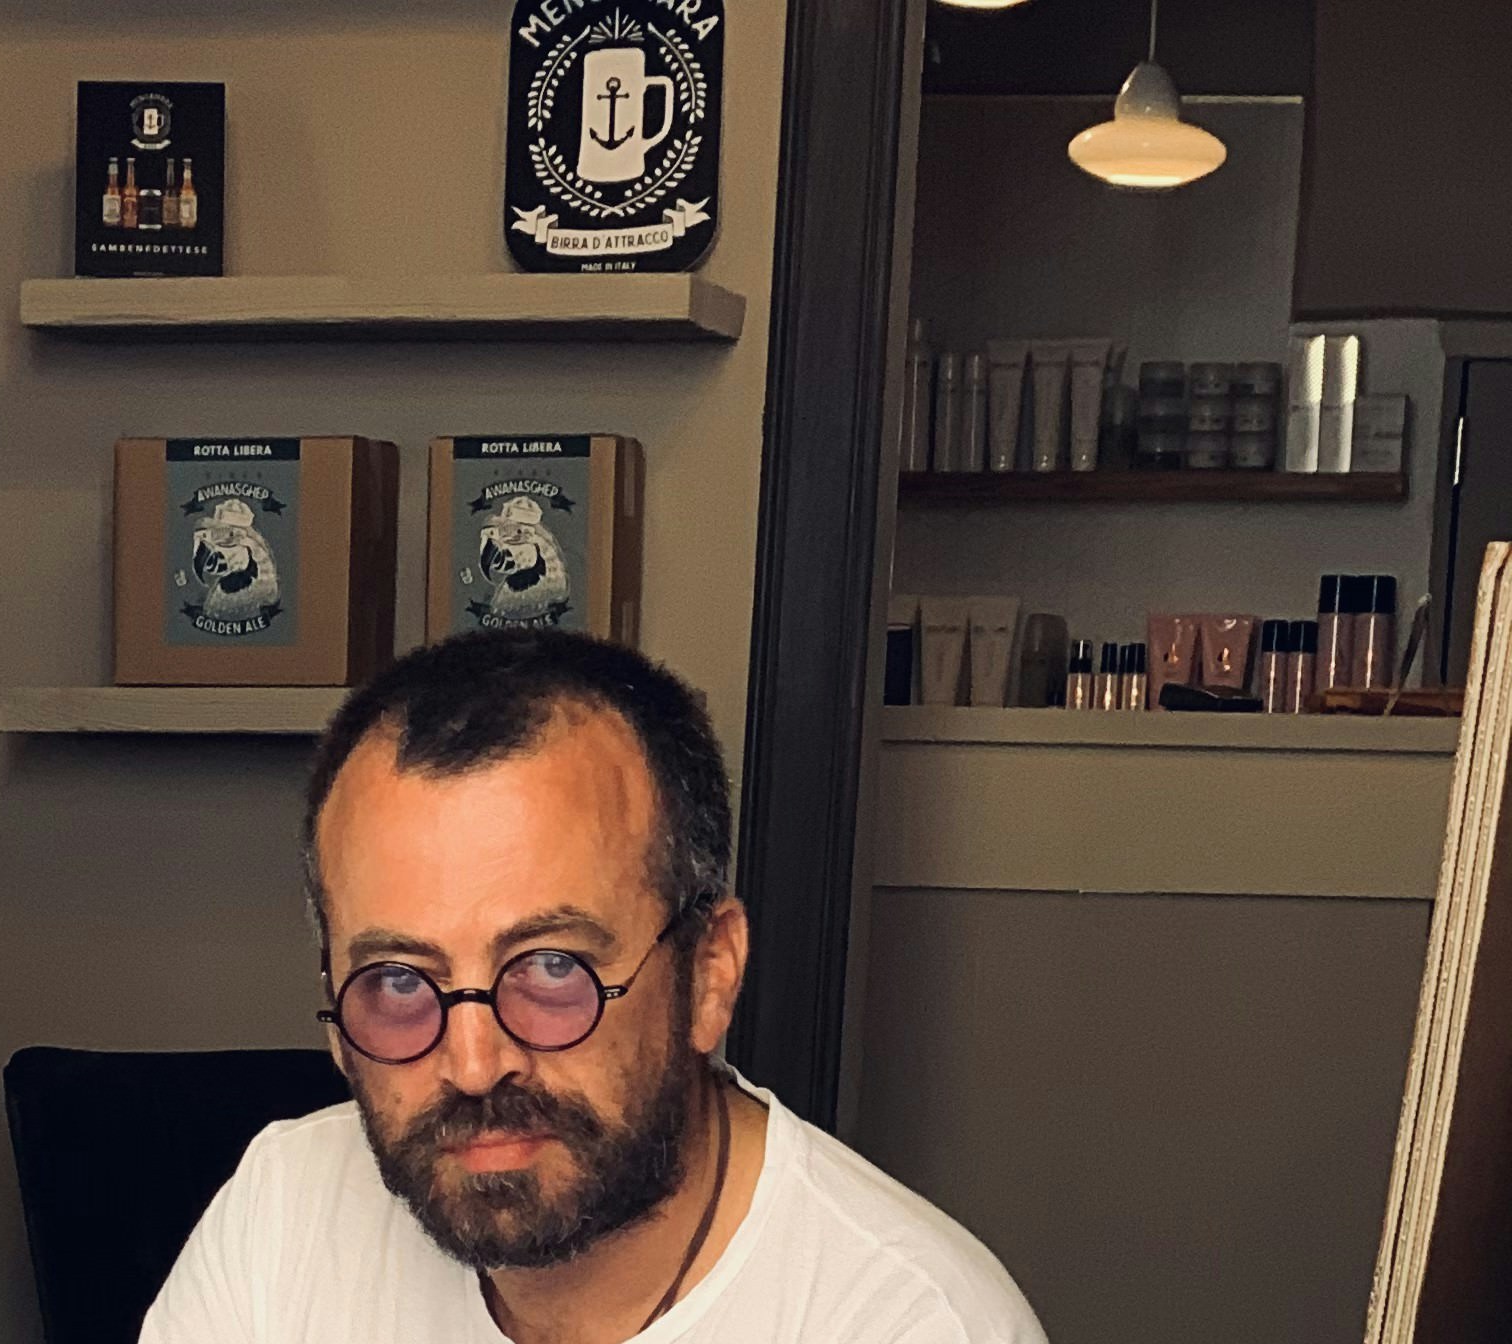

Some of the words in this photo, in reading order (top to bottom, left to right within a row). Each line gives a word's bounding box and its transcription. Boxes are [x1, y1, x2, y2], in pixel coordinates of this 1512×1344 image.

[550, 235, 588, 249] BIRRA
[91, 243, 208, 254] SAMBENEDETTESE
[615, 261, 637, 271] ITALY
[193, 444, 230, 456] ROTTA
[234, 444, 273, 456] LIBERA
[481, 442, 520, 454] ROTTA
[522, 441, 562, 453] LIBERA
[195, 615, 242, 635] GOLDEN
[245, 616, 267, 632] ALE
